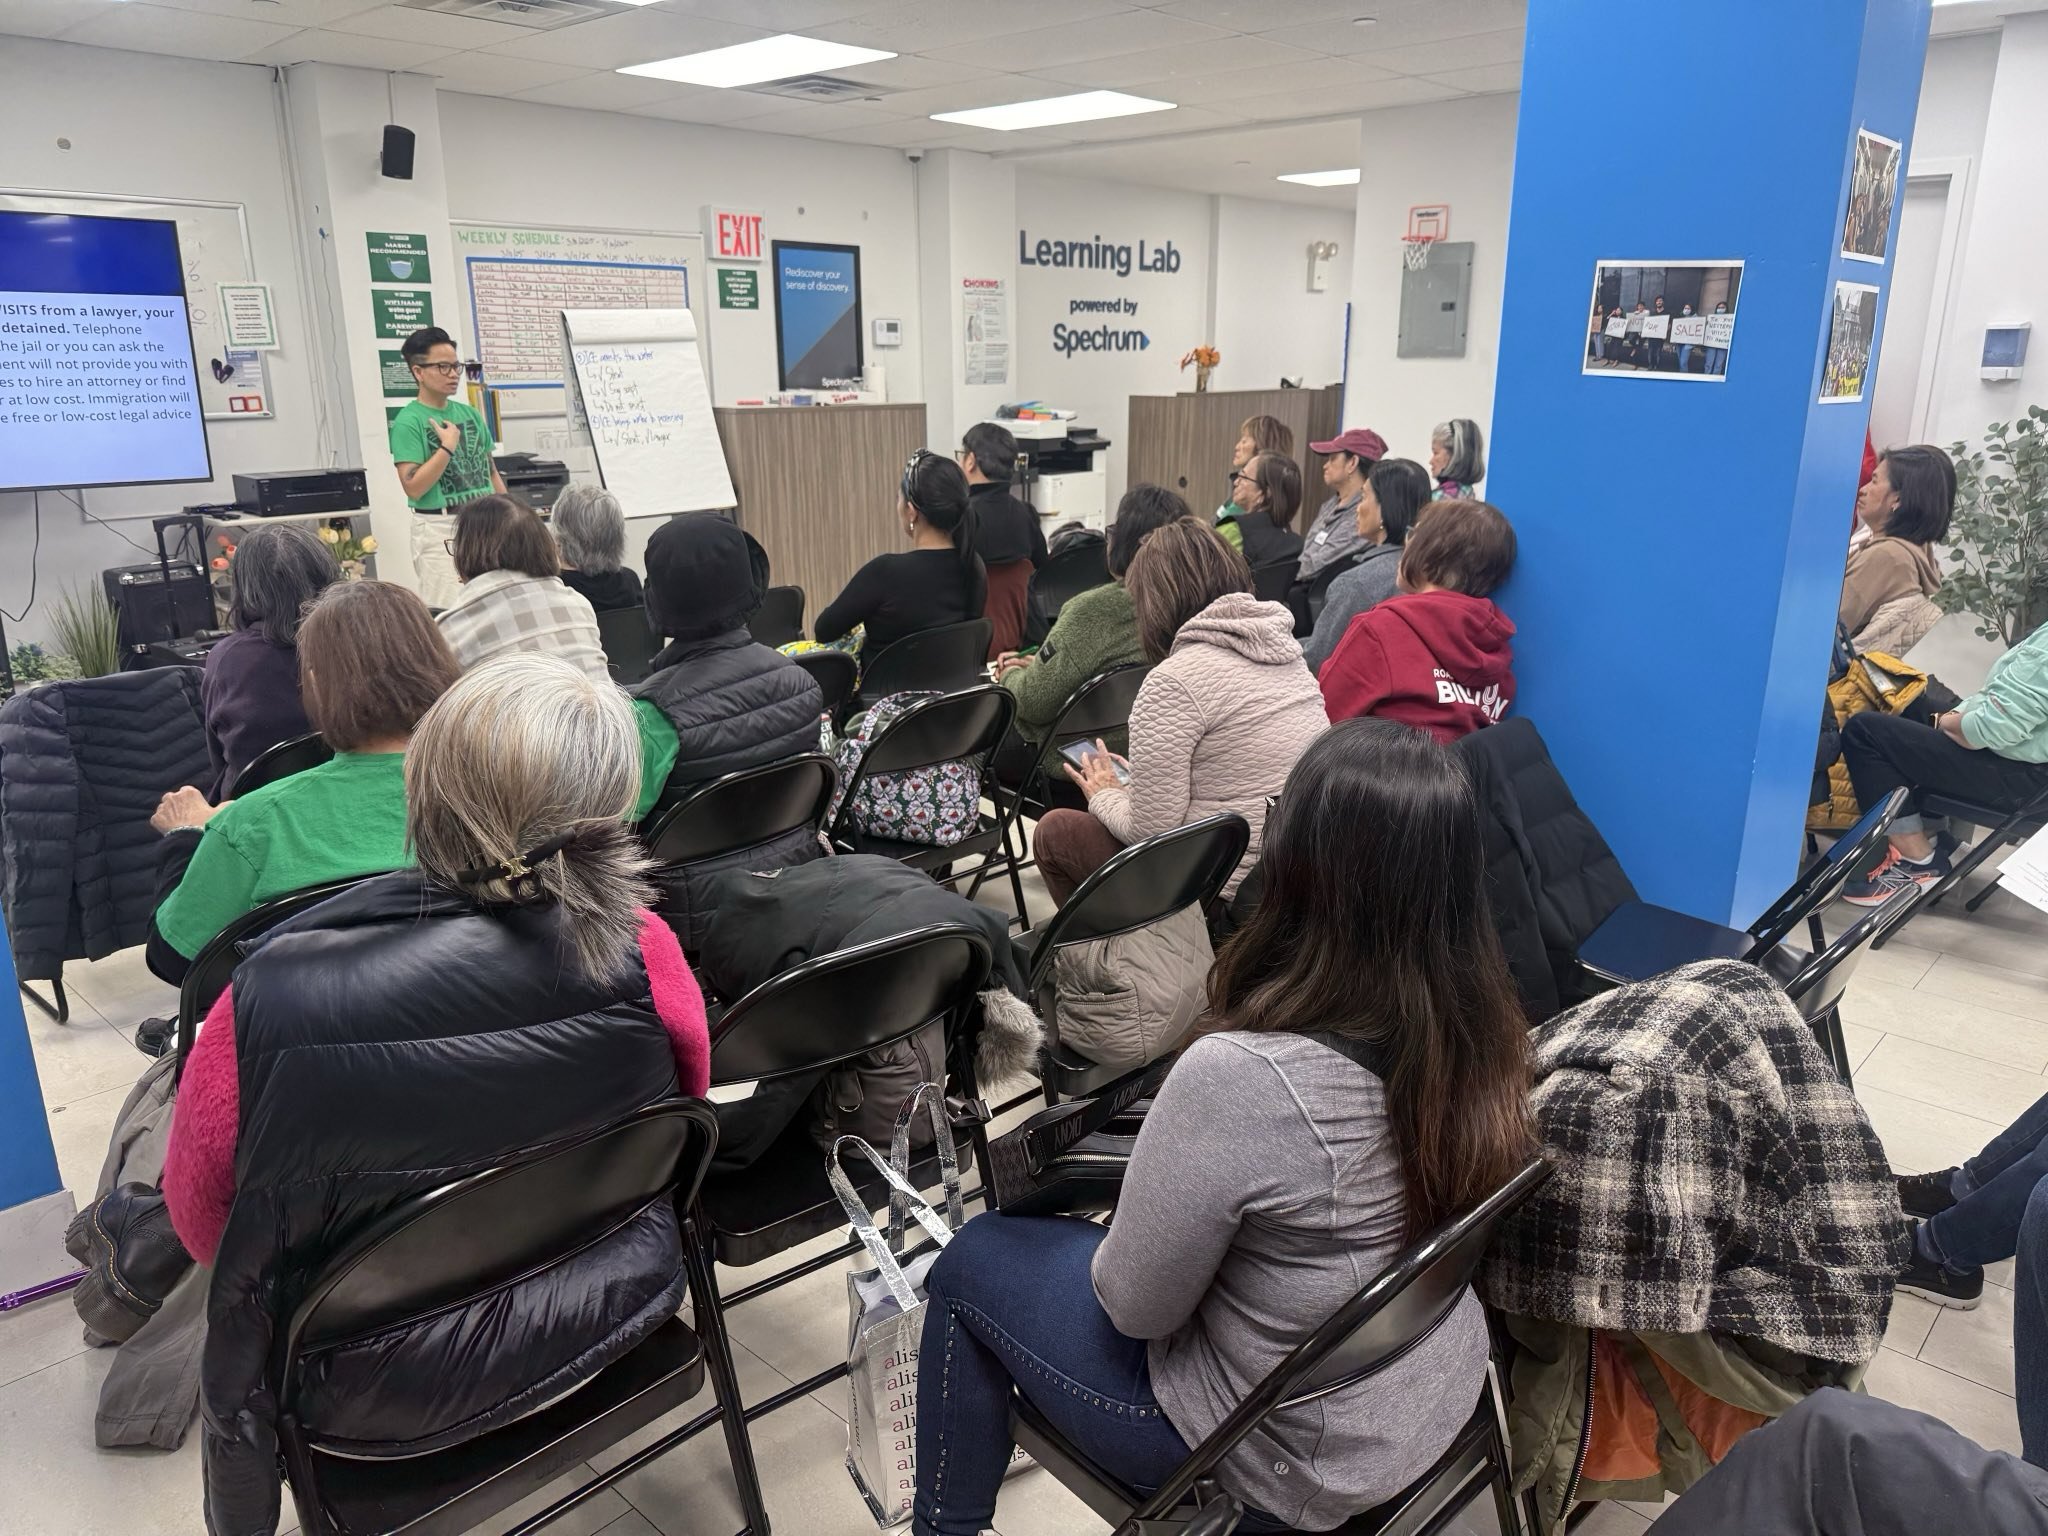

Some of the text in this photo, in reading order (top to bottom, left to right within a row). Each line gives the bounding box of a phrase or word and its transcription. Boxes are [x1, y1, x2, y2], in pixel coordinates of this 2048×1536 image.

[458, 231, 507, 245] WEEKLY
[719, 214, 762, 257] EXIT
[1020, 230, 1181, 277] Learning Lab
[785, 267, 841, 280] Rediscover your
[785, 281, 807, 290] sense
[807, 281, 815, 290] of
[0, 304, 175, 320] ISITS from a lawyer, your
[1070, 298, 1138, 316] powered by
[2, 322, 142, 337] detained. Telephone
[1674, 323, 1703, 337] SALE
[22, 341, 42, 354] jail
[46, 344, 60, 352] or
[64, 344, 89, 354] you
[92, 344, 115, 352] can
[119, 341, 140, 352] ask
[143, 342, 165, 352] the
[1053, 323, 1150, 359] Spectrum
[28, 358, 52, 369] will
[56, 360, 79, 369] not
[82, 359, 131, 372] provide
[135, 360, 158, 371] you
[161, 358, 188, 369] with
[0, 375, 186, 389] es to hire an attorney or find
[8, 395, 23, 405] at
[26, 394, 50, 405] low
[54, 395, 85, 405] cost.
[88, 392, 167, 406] Immigration
[169, 392, 191, 403] will
[12, 412, 40, 423] free
[44, 414, 58, 422] or
[62, 411, 116, 422] low-cost
[120, 410, 149, 422] legal
[152, 409, 192, 420] advice
[1109, 1079, 1144, 1116] DKNY
[1054, 1114, 1083, 1151] DKNY
[884, 1347, 920, 1370] alis
[890, 1391, 917, 1412] ali
